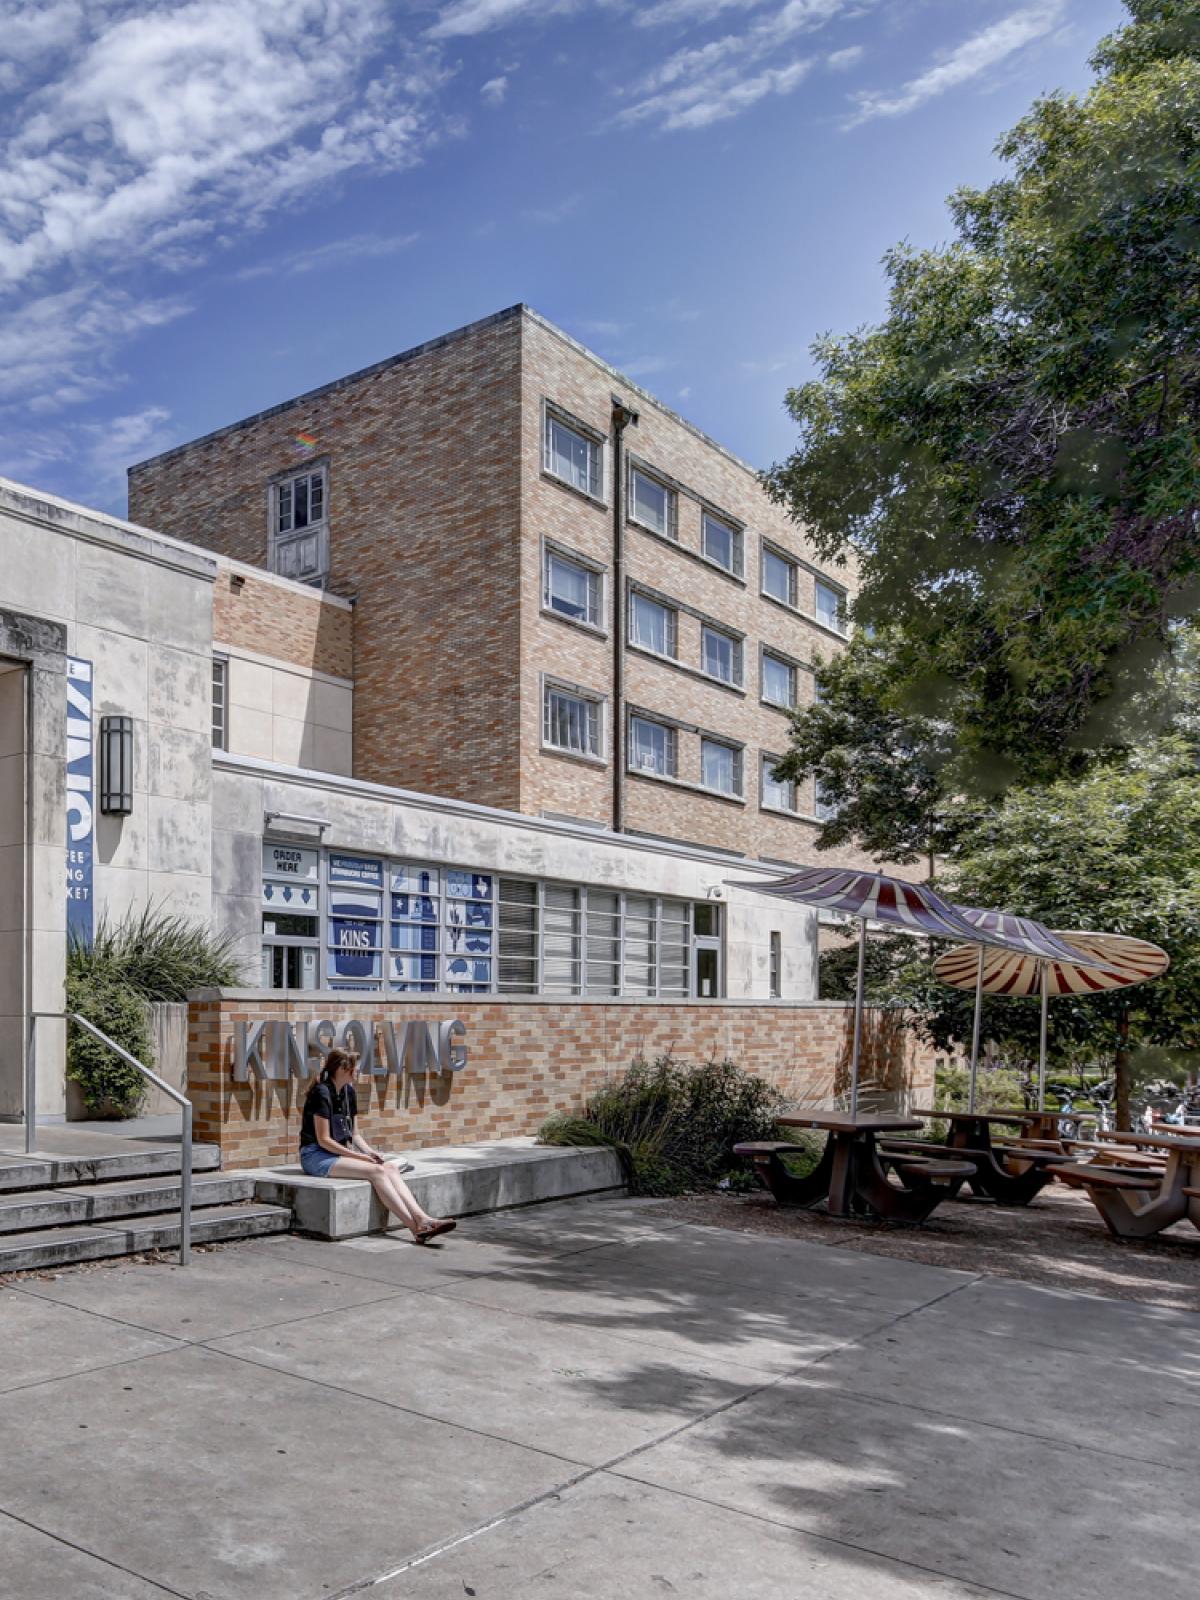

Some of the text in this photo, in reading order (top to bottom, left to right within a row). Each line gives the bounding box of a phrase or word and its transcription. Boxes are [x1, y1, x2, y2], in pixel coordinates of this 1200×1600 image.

[273, 849, 302, 862] ORDER
[276, 861, 299, 873] HERE
[340, 929, 370, 948] KINS
[233, 1019, 468, 1082] KINSOLVING
